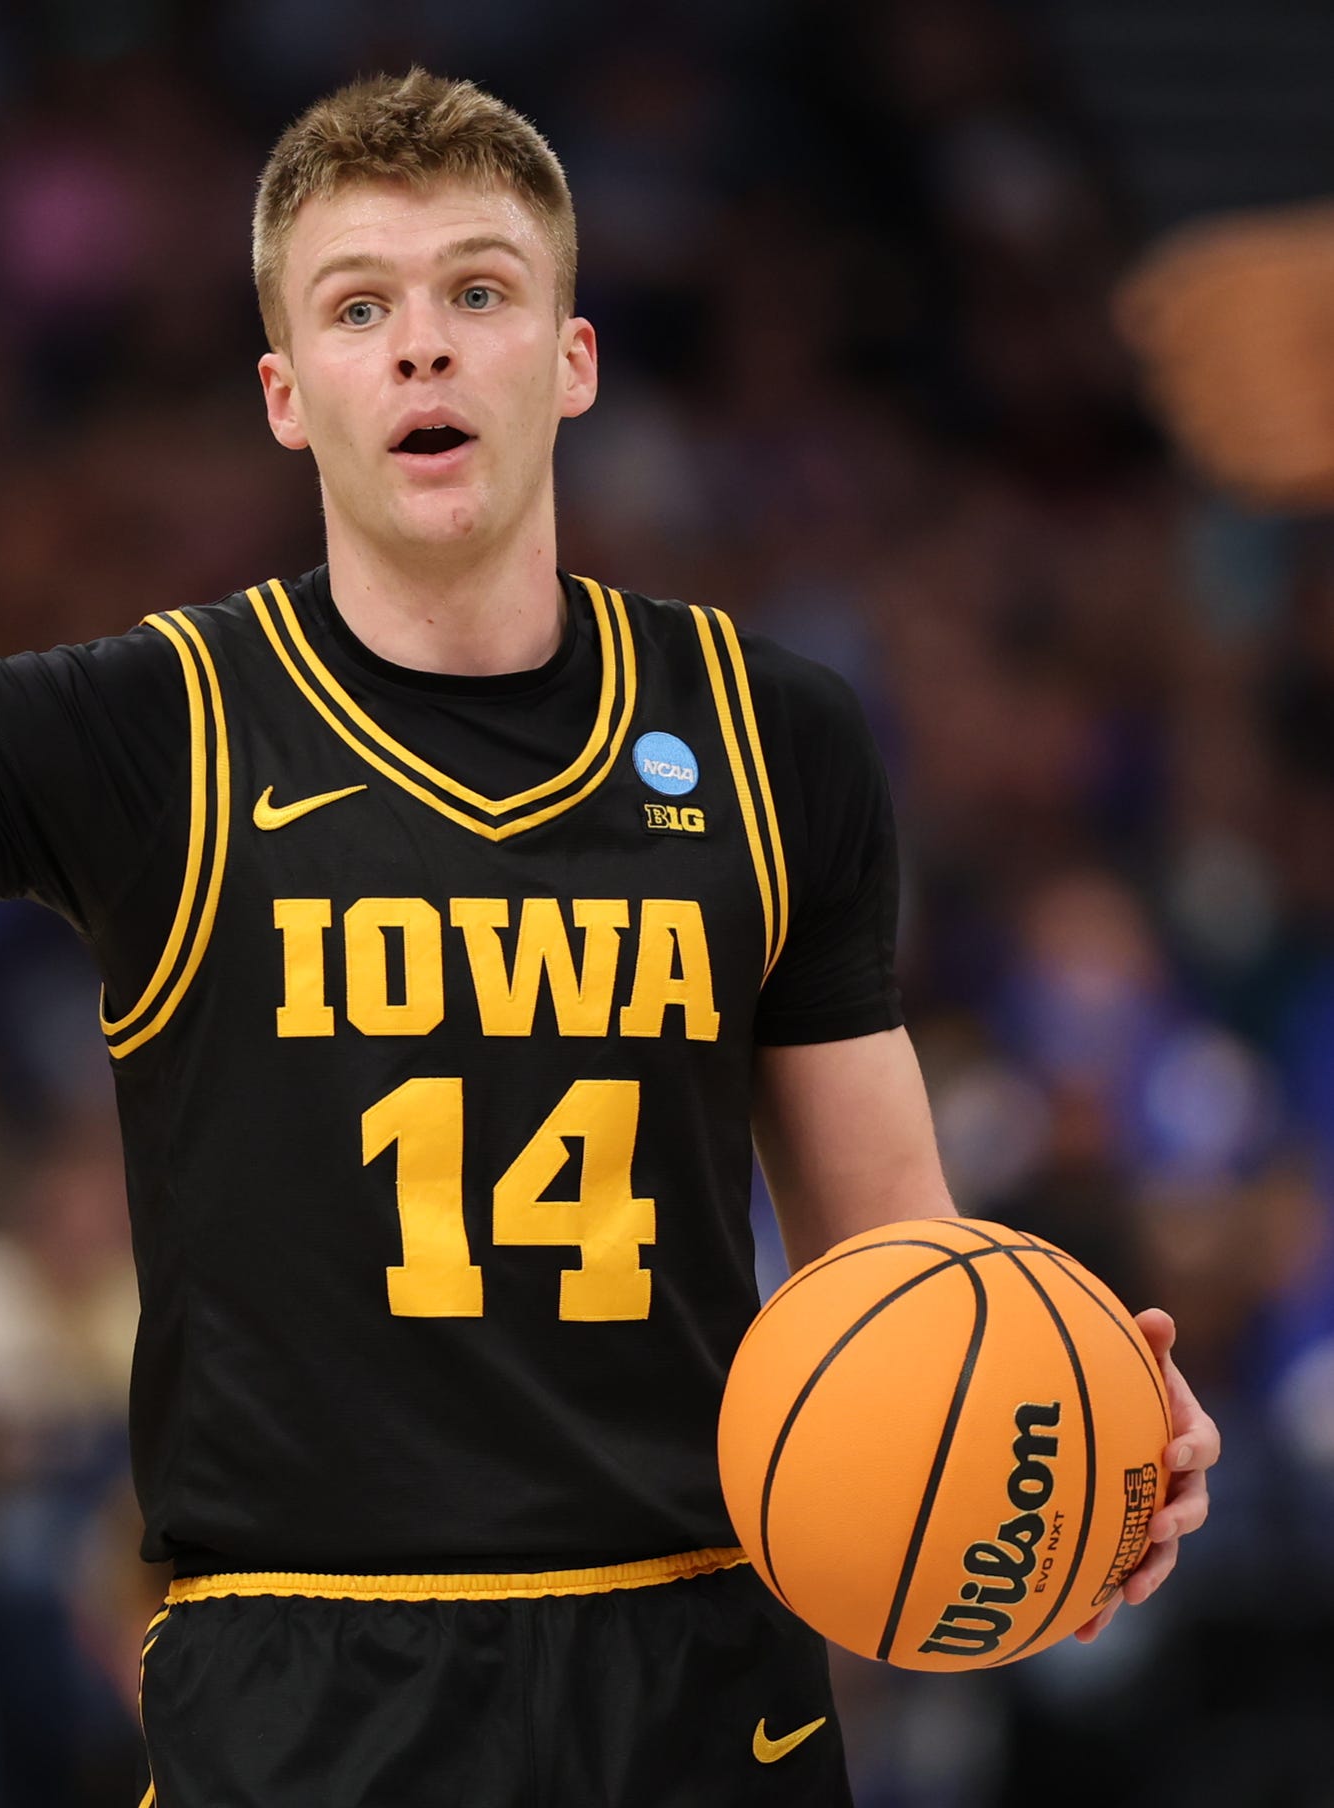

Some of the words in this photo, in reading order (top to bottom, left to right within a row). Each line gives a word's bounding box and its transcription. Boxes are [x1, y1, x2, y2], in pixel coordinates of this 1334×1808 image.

[643, 758, 695, 783] NCAA
[272, 897, 721, 1042] IOWA
[360, 1077, 656, 1321] 14
[917, 1400, 1061, 1656] Wilson
[1034, 1557, 1054, 1594] EVO
[1047, 1510, 1065, 1551] NXT
[1106, 1511, 1139, 1586] MARCH
